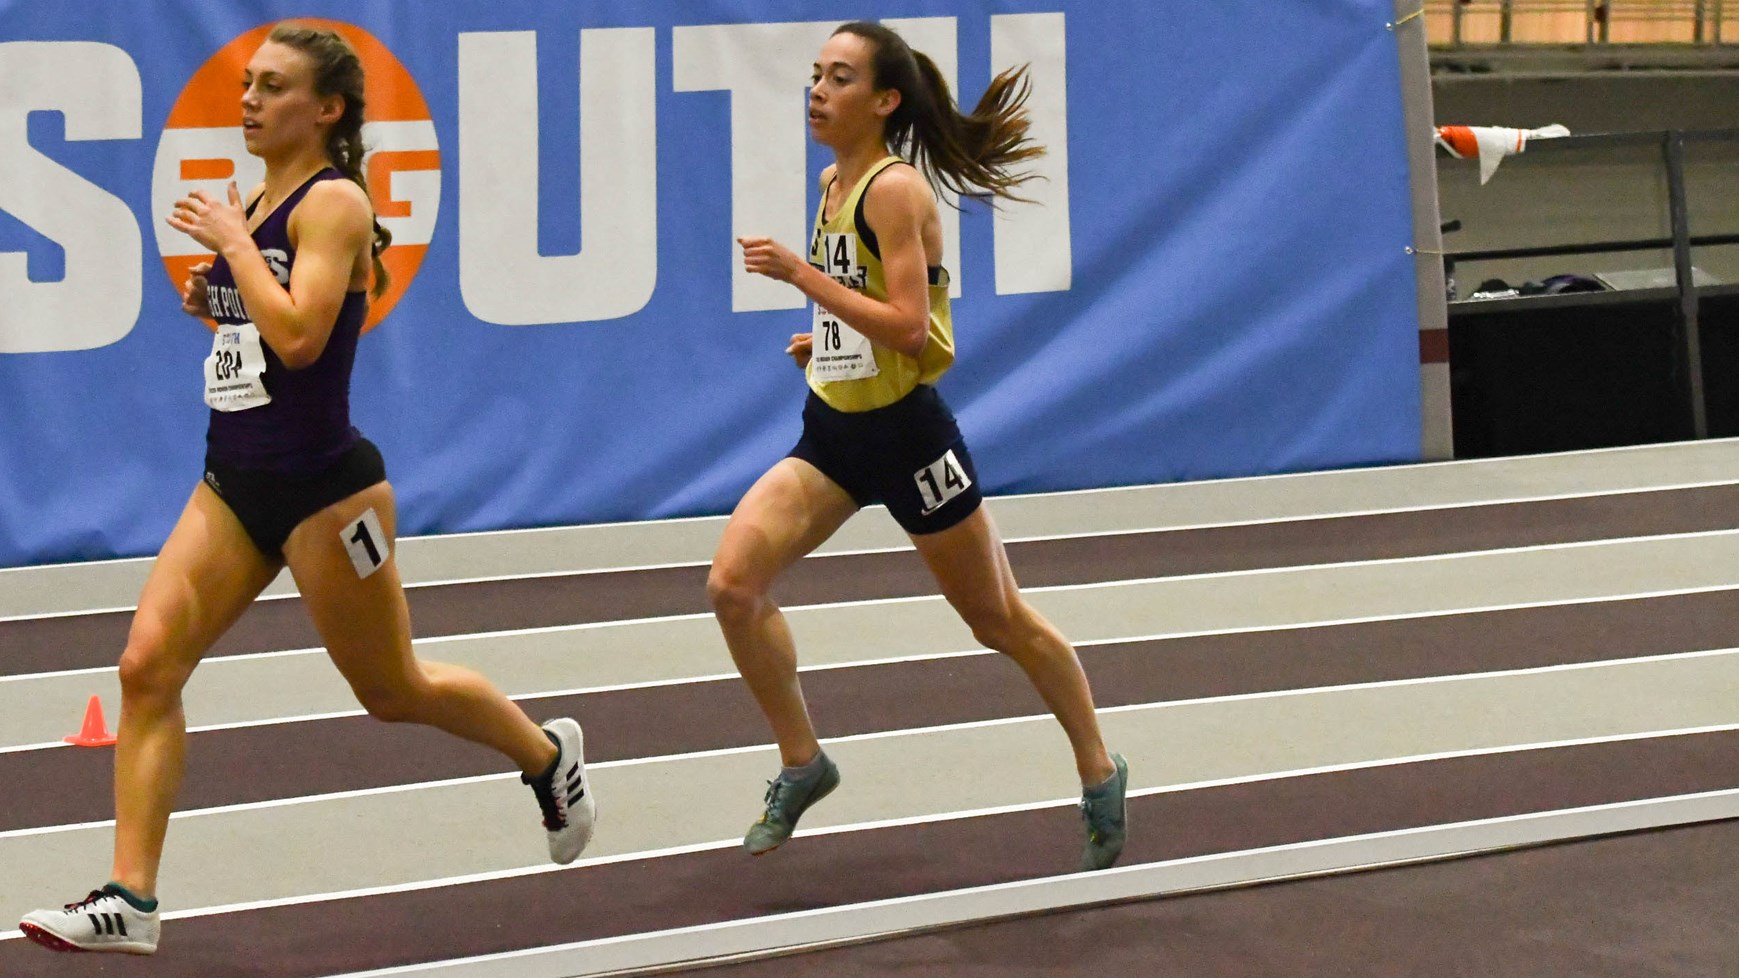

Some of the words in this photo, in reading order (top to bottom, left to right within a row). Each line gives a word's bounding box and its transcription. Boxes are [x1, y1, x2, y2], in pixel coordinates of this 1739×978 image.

[825, 235, 850, 274] 14
[822, 320, 841, 351] 78
[215, 350, 243, 381] 204
[919, 456, 965, 503] 14
[350, 520, 381, 567] 1
